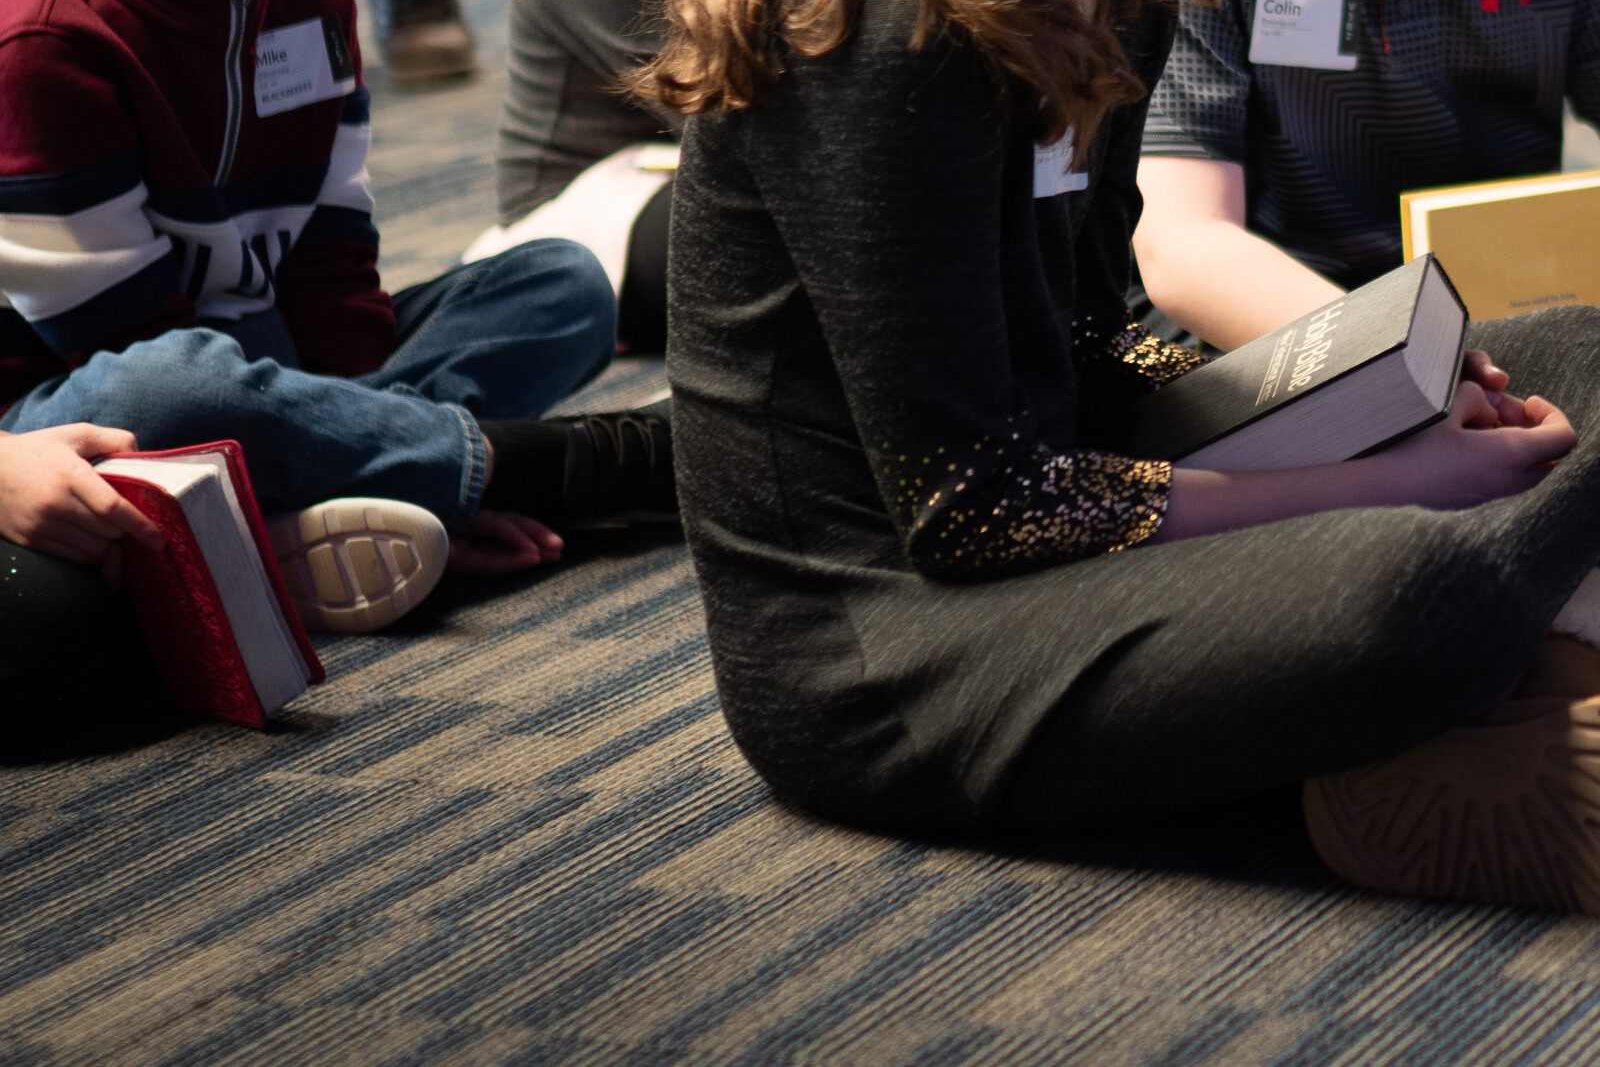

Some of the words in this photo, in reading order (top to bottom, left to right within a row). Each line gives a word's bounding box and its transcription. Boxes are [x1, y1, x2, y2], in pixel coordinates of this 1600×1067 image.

[256, 48, 288, 68] Mike
[1294, 301, 1345, 352] Holy
[1287, 339, 1333, 392] Bible
